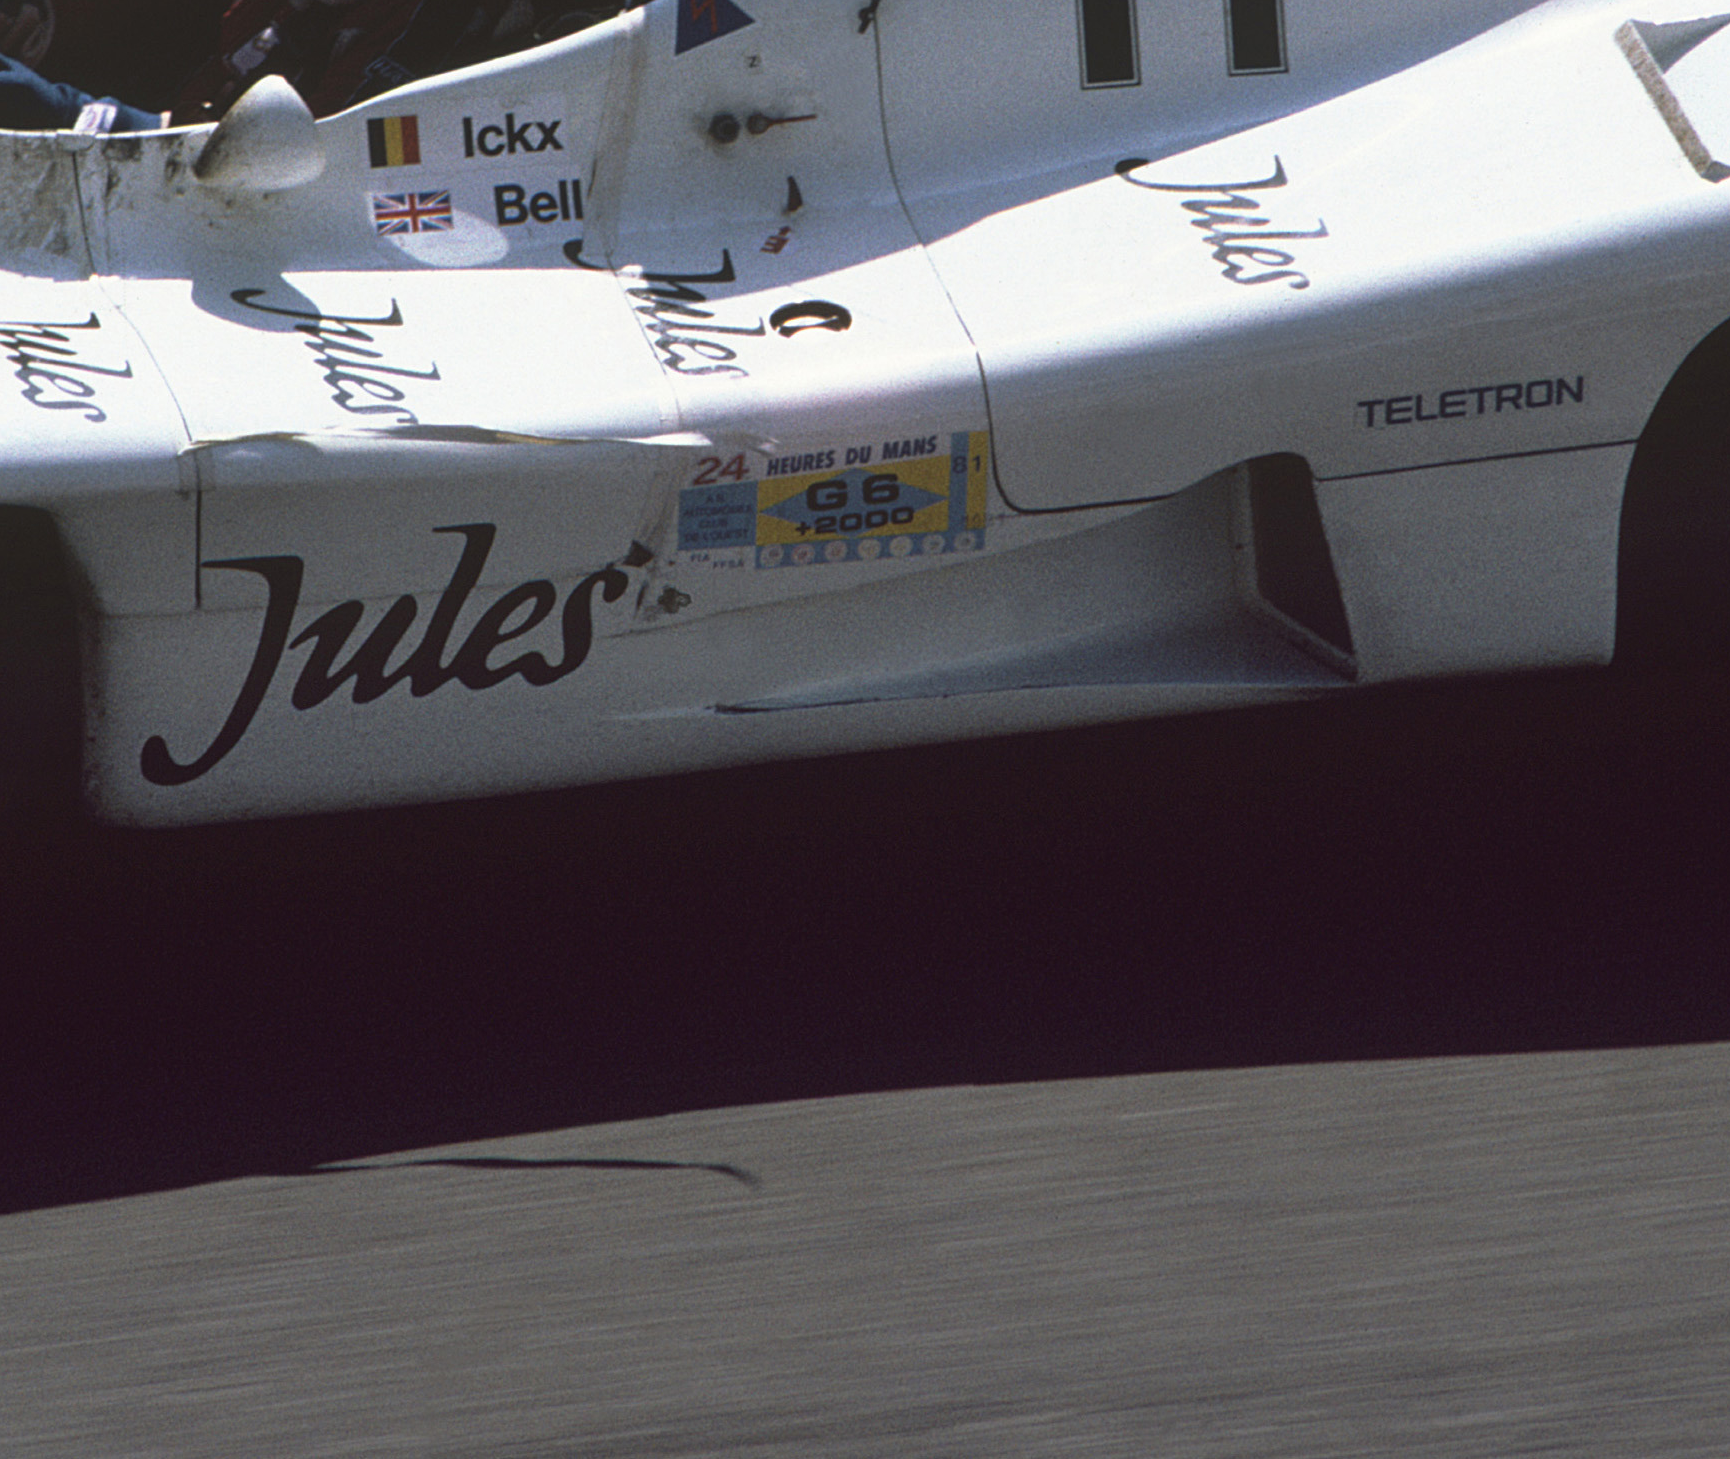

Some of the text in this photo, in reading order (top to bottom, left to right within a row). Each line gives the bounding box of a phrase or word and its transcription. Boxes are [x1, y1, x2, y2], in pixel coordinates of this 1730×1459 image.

[462, 114, 564, 159] Ickx
[493, 180, 583, 227] Bell
[1115, 155, 1329, 291] Jules
[563, 238, 766, 379] Jules
[230, 288, 441, 426] Jules
[1357, 375, 1585, 429] TELETRON
[692, 435, 938, 486] 24 HEURES DU MANS
[805, 472, 900, 512] G 6
[794, 506, 915, 536] +2000
[139, 521, 629, 787] Jules
